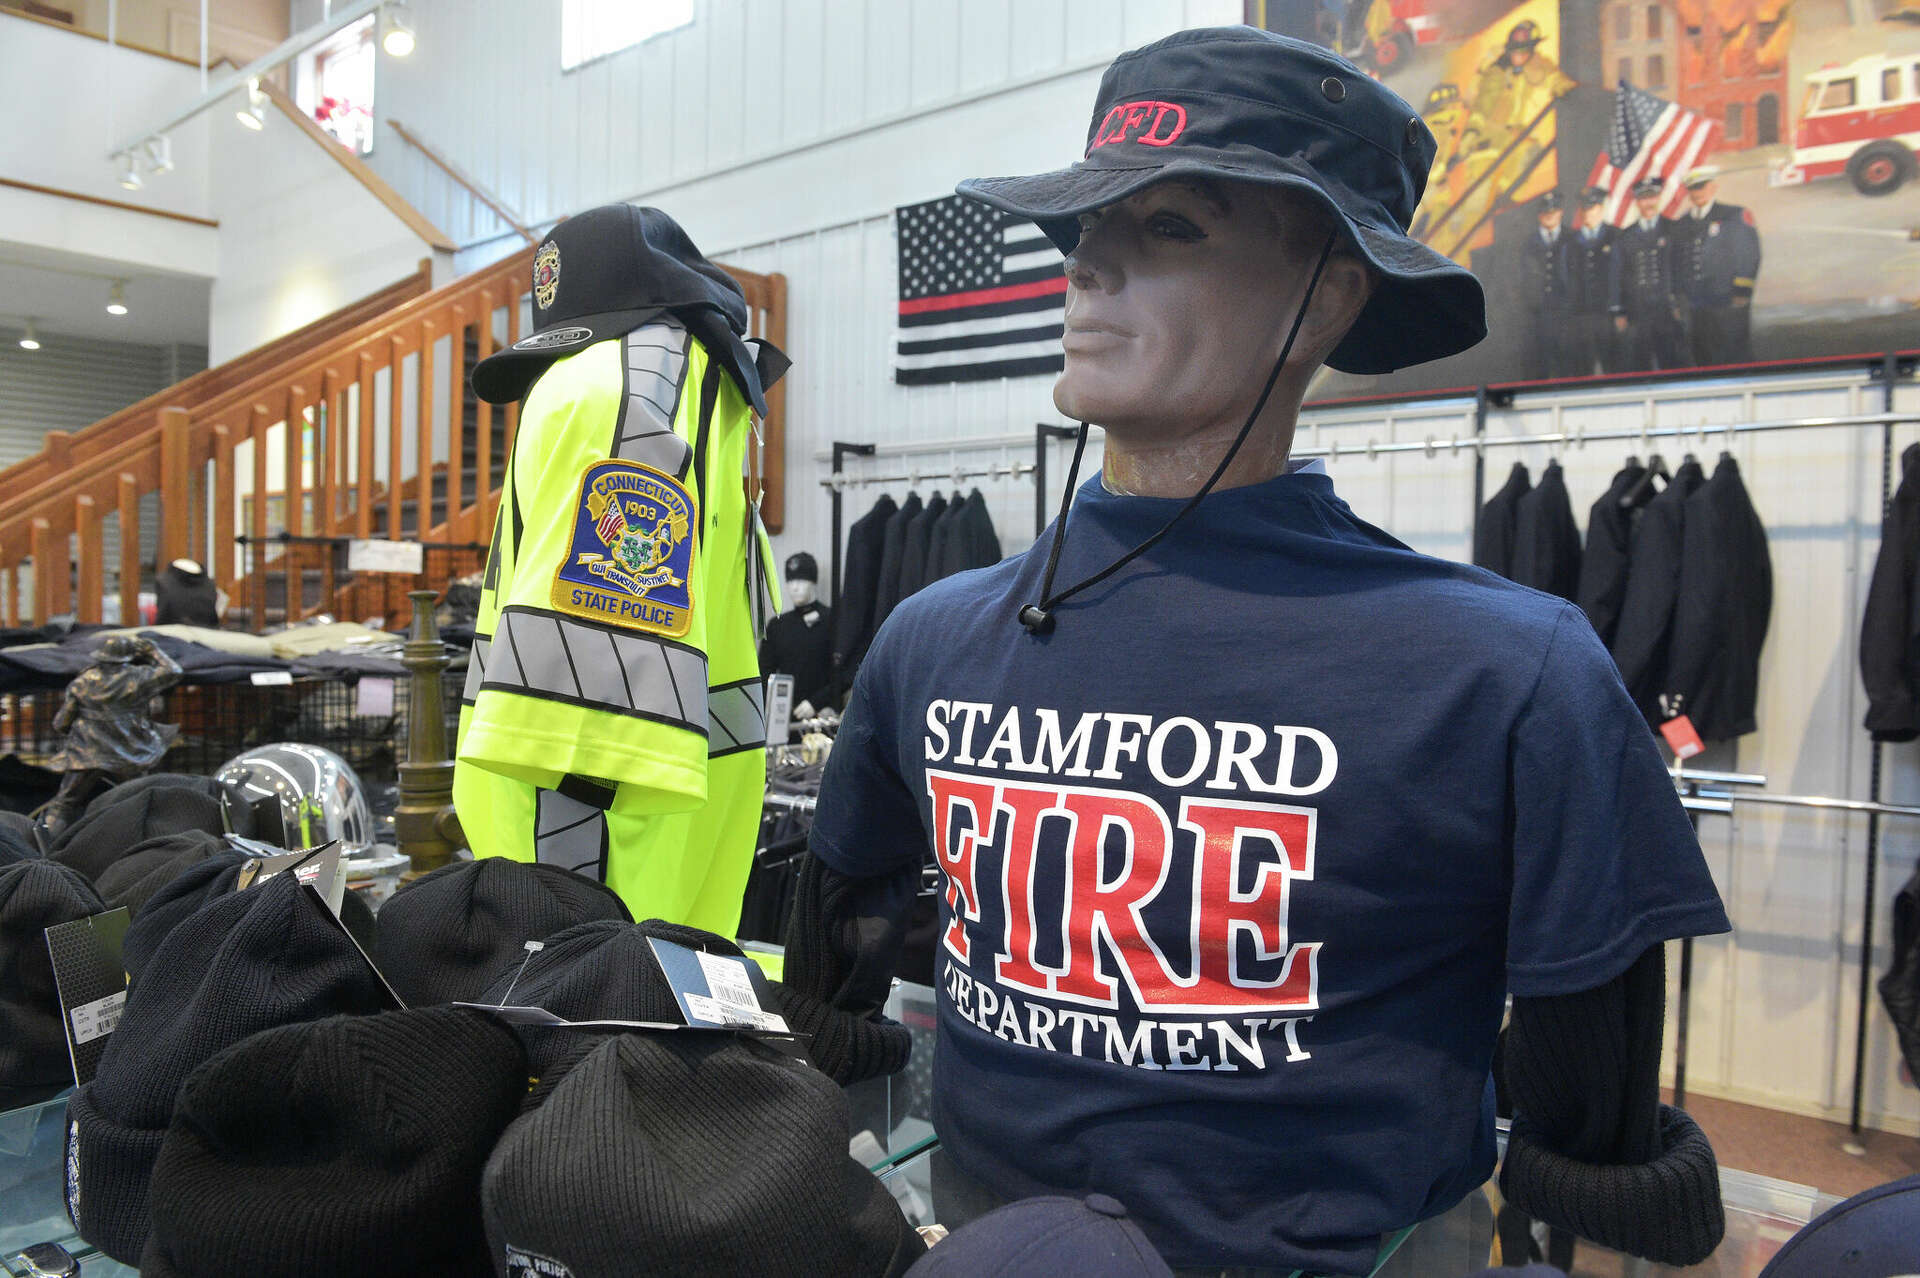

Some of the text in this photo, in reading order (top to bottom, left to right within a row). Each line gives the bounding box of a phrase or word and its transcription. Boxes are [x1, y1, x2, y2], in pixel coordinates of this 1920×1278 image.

[595, 474, 688, 517] CONNECTICUT
[624, 500, 657, 521] 1903
[606, 570, 646, 597] TRANSTULIT
[636, 572, 671, 587] SUSTINET
[571, 589, 675, 627] STATE POLICE
[925, 698, 1339, 796] STAMFORD
[925, 767, 1324, 1014] FIRE
[943, 959, 1315, 1072] DEPARTMENT
